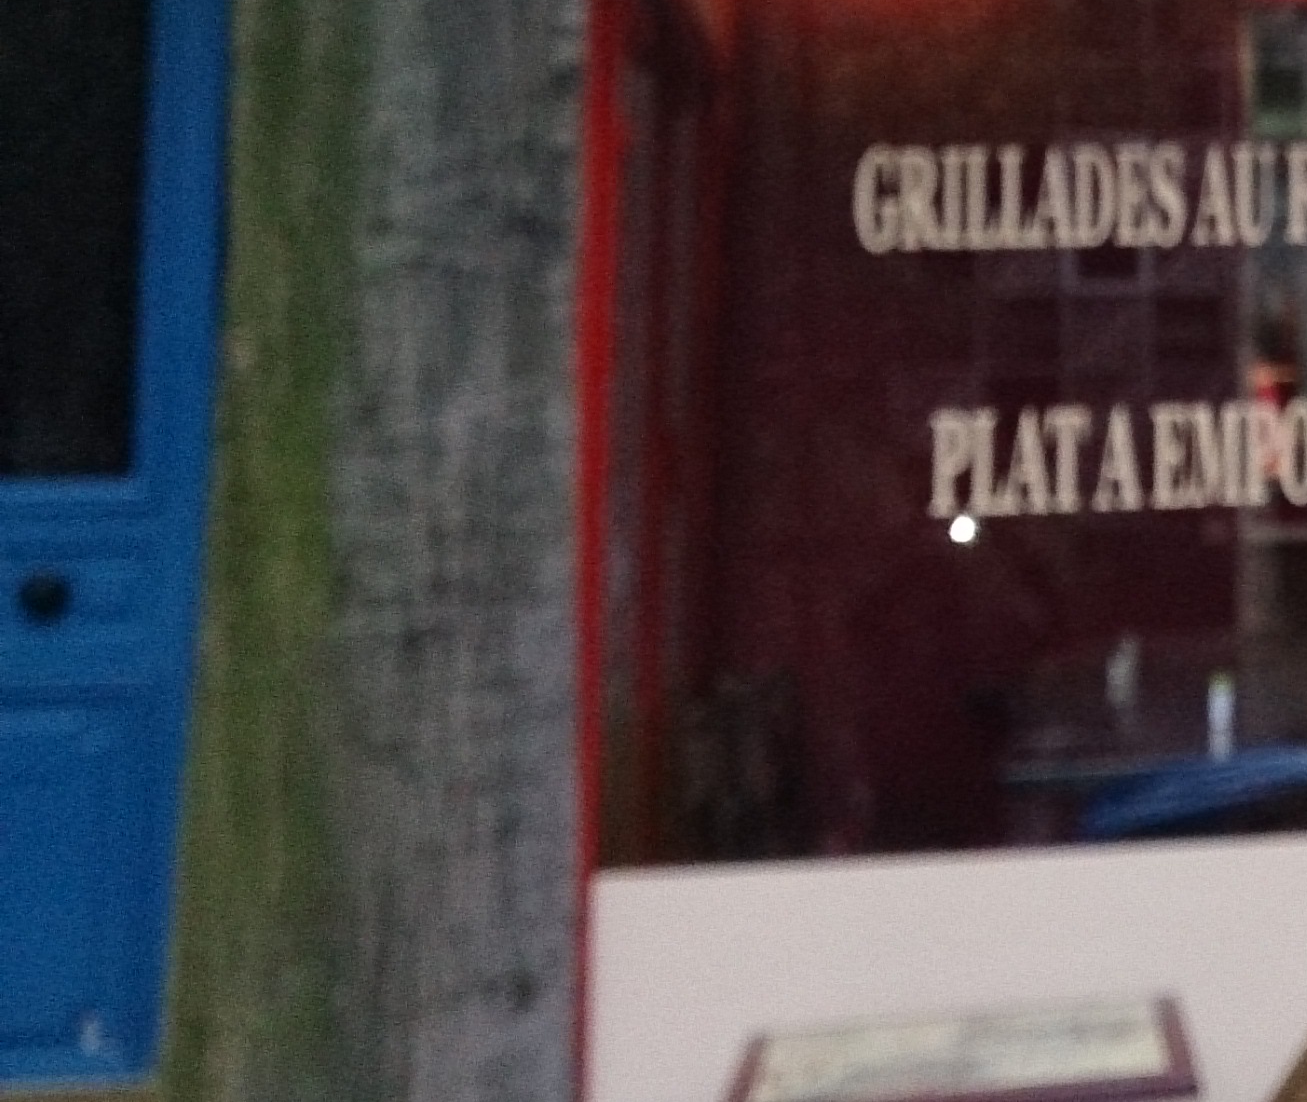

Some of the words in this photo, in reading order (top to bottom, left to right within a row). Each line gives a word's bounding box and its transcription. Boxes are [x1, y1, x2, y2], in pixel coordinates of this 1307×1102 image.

[852, 144, 1187, 253] GRILLADES
[1195, 144, 1277, 247] AU
[928, 404, 1091, 517] PLAT
[1092, 402, 1144, 512] A
